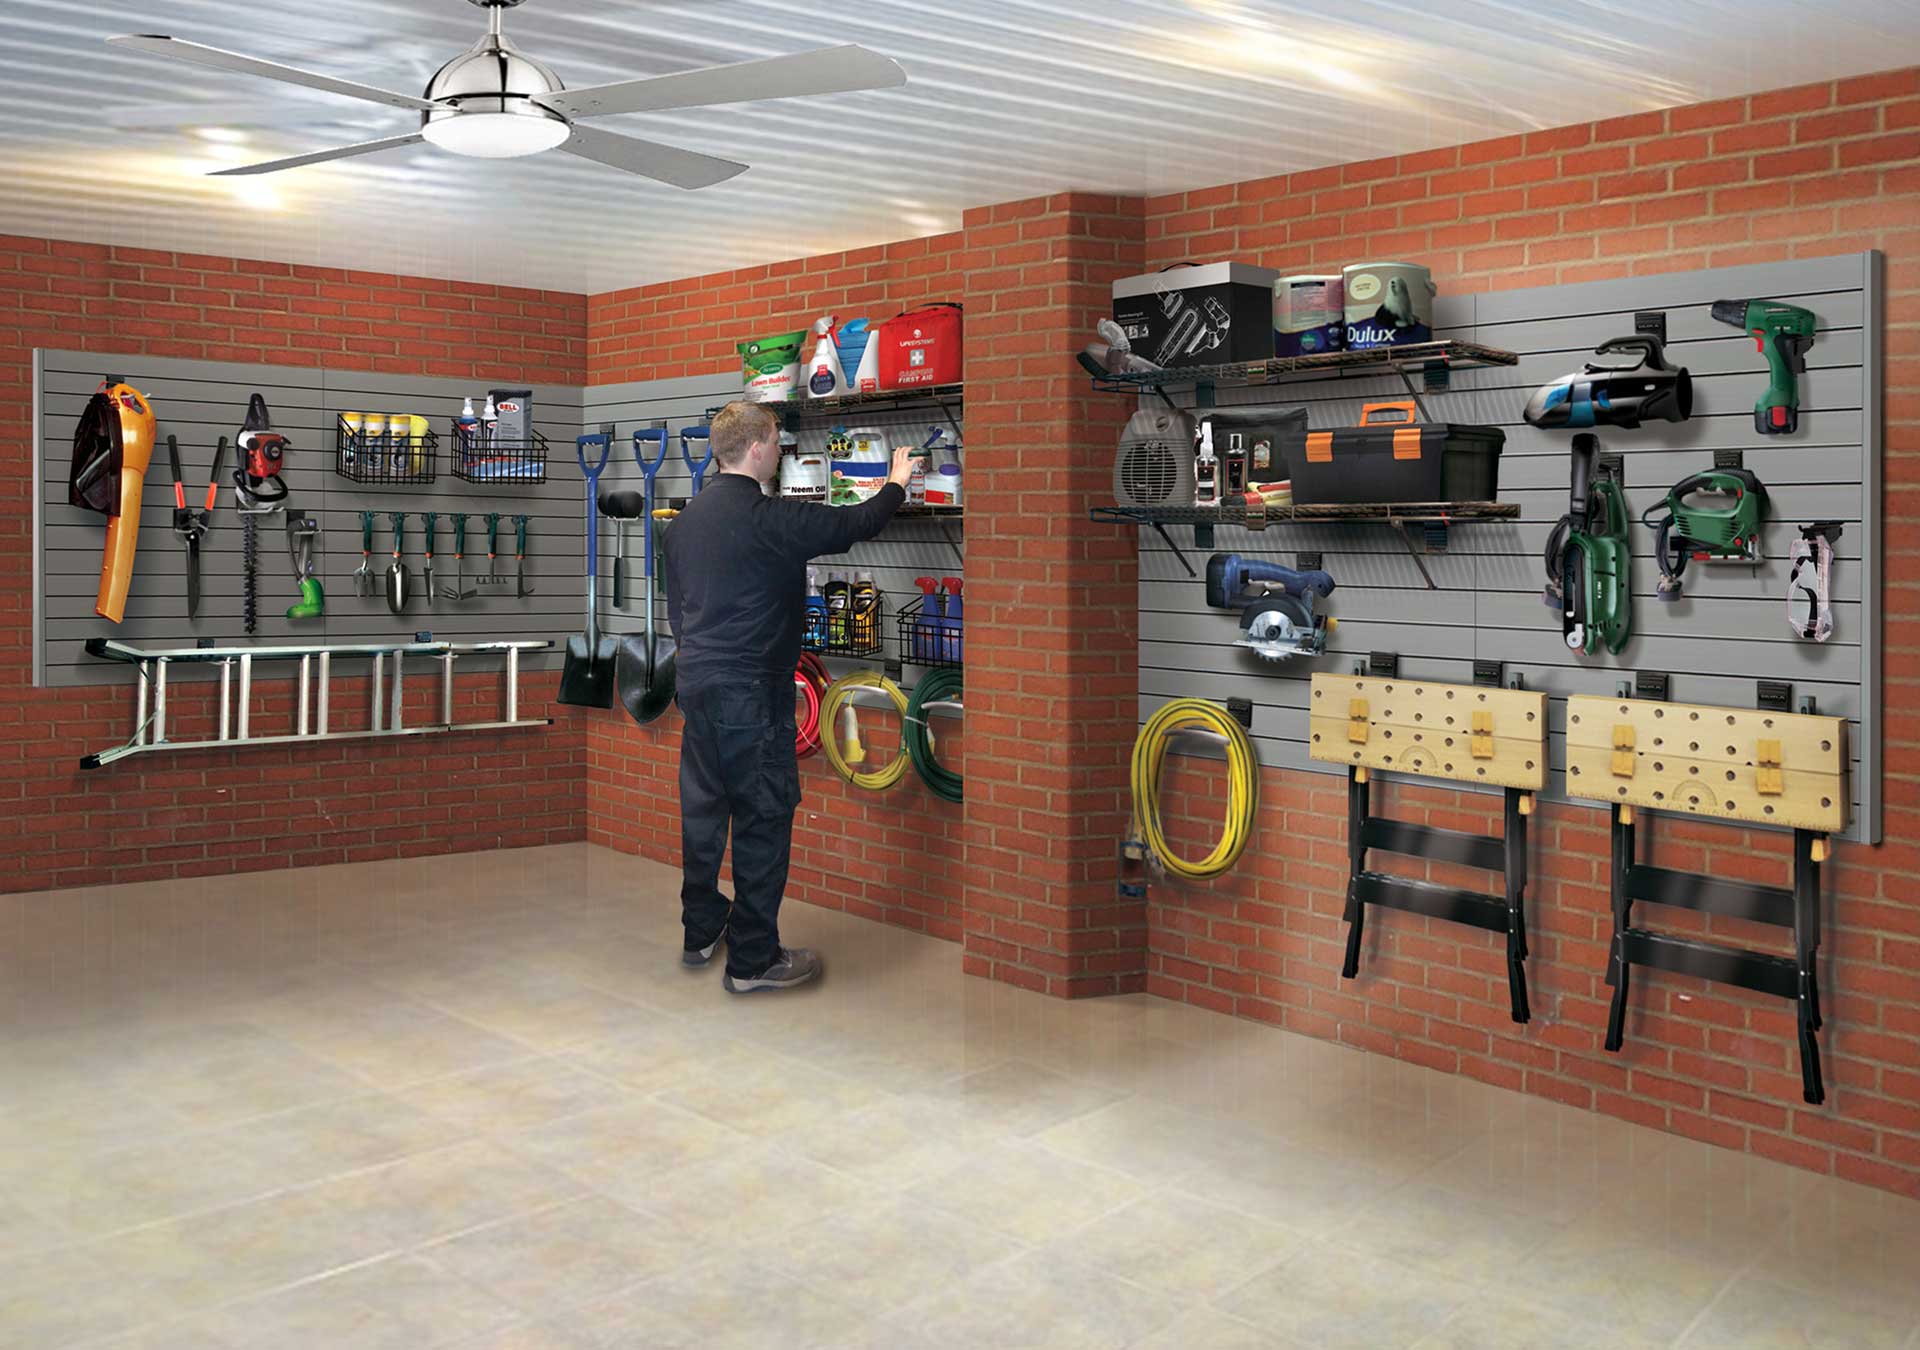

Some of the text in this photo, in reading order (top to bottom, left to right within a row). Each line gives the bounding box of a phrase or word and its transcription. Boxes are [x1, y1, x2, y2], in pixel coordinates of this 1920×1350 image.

[1347, 326, 1398, 343] Dulux
[769, 375, 791, 385] Builder
[898, 376, 920, 384] FIRST
[499, 403, 517, 411] BELL
[831, 443, 848, 452] PET
